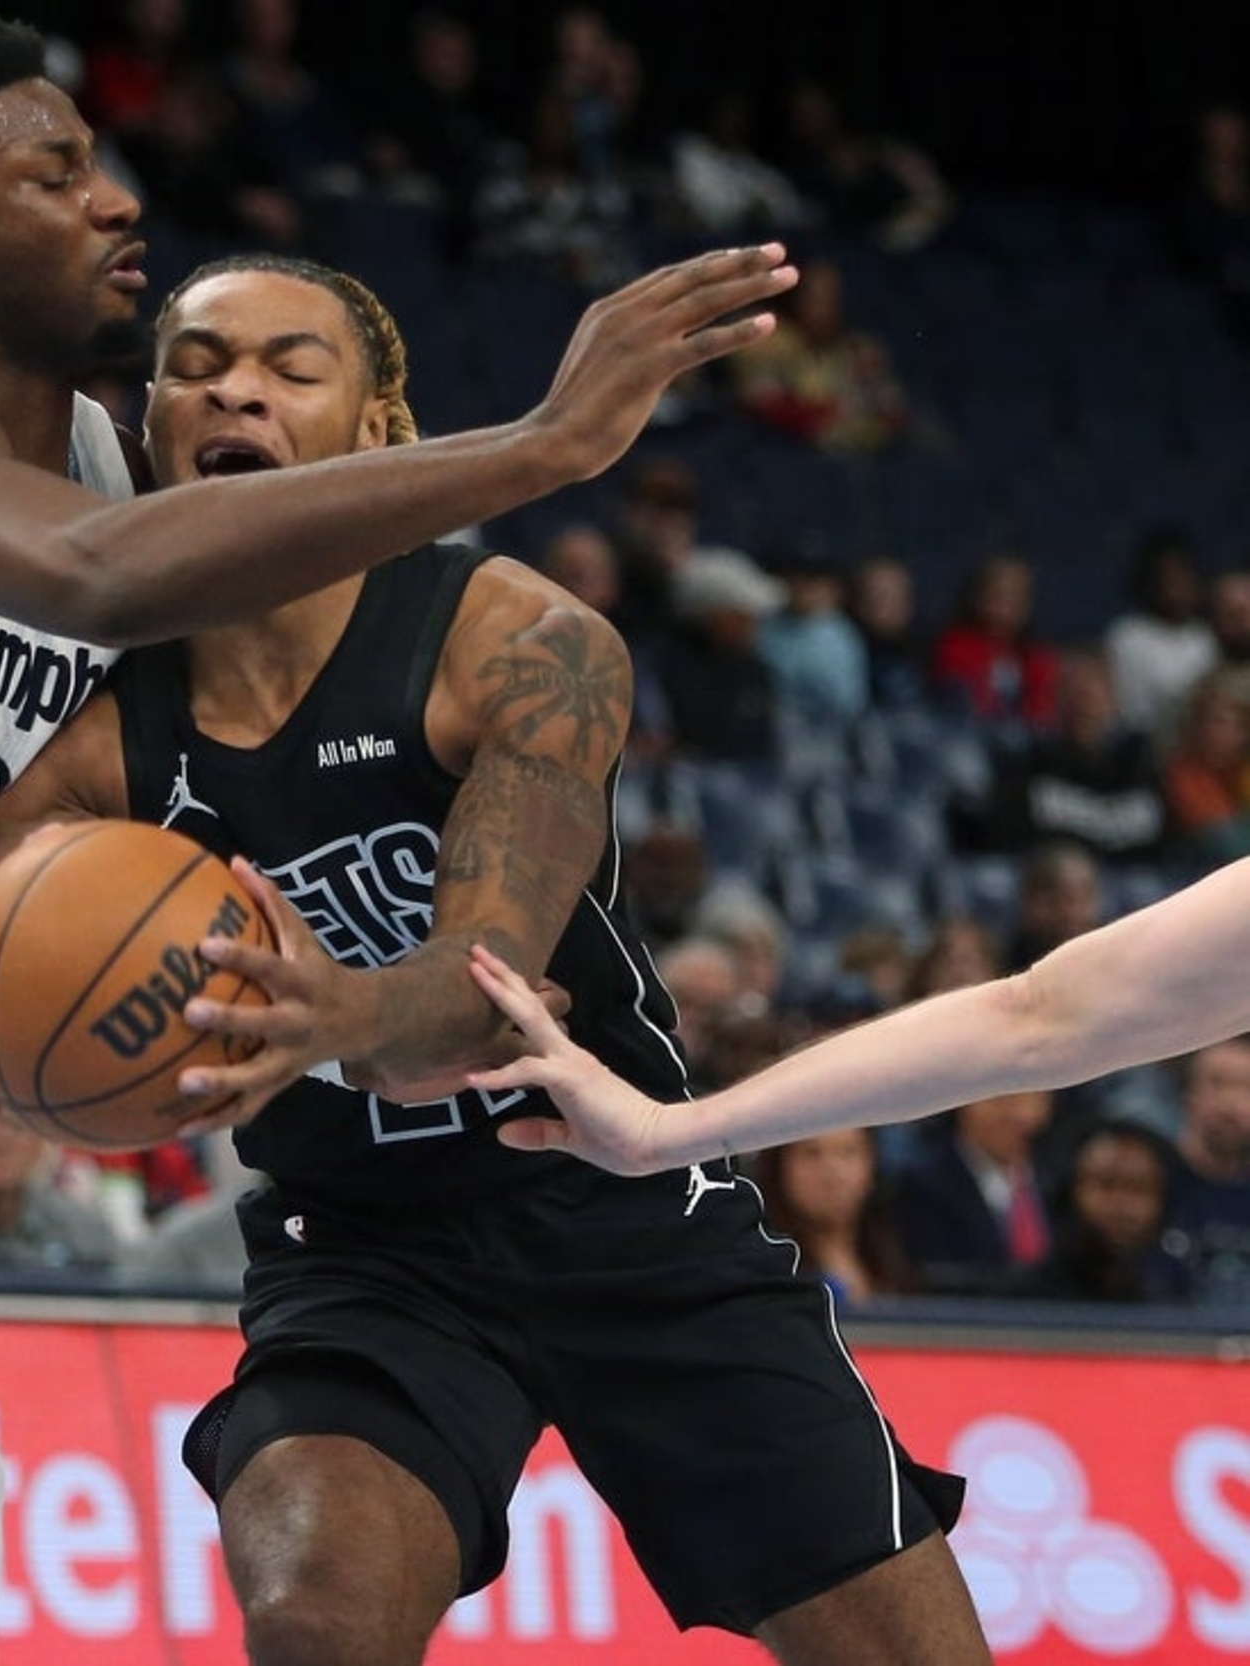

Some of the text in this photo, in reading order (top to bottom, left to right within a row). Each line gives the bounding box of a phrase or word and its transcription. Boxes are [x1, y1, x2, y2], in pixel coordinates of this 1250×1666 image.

[317, 734, 397, 768] All In Won
[90, 892, 249, 1060] Wilsn
[153, 1404, 618, 1640] Fm
